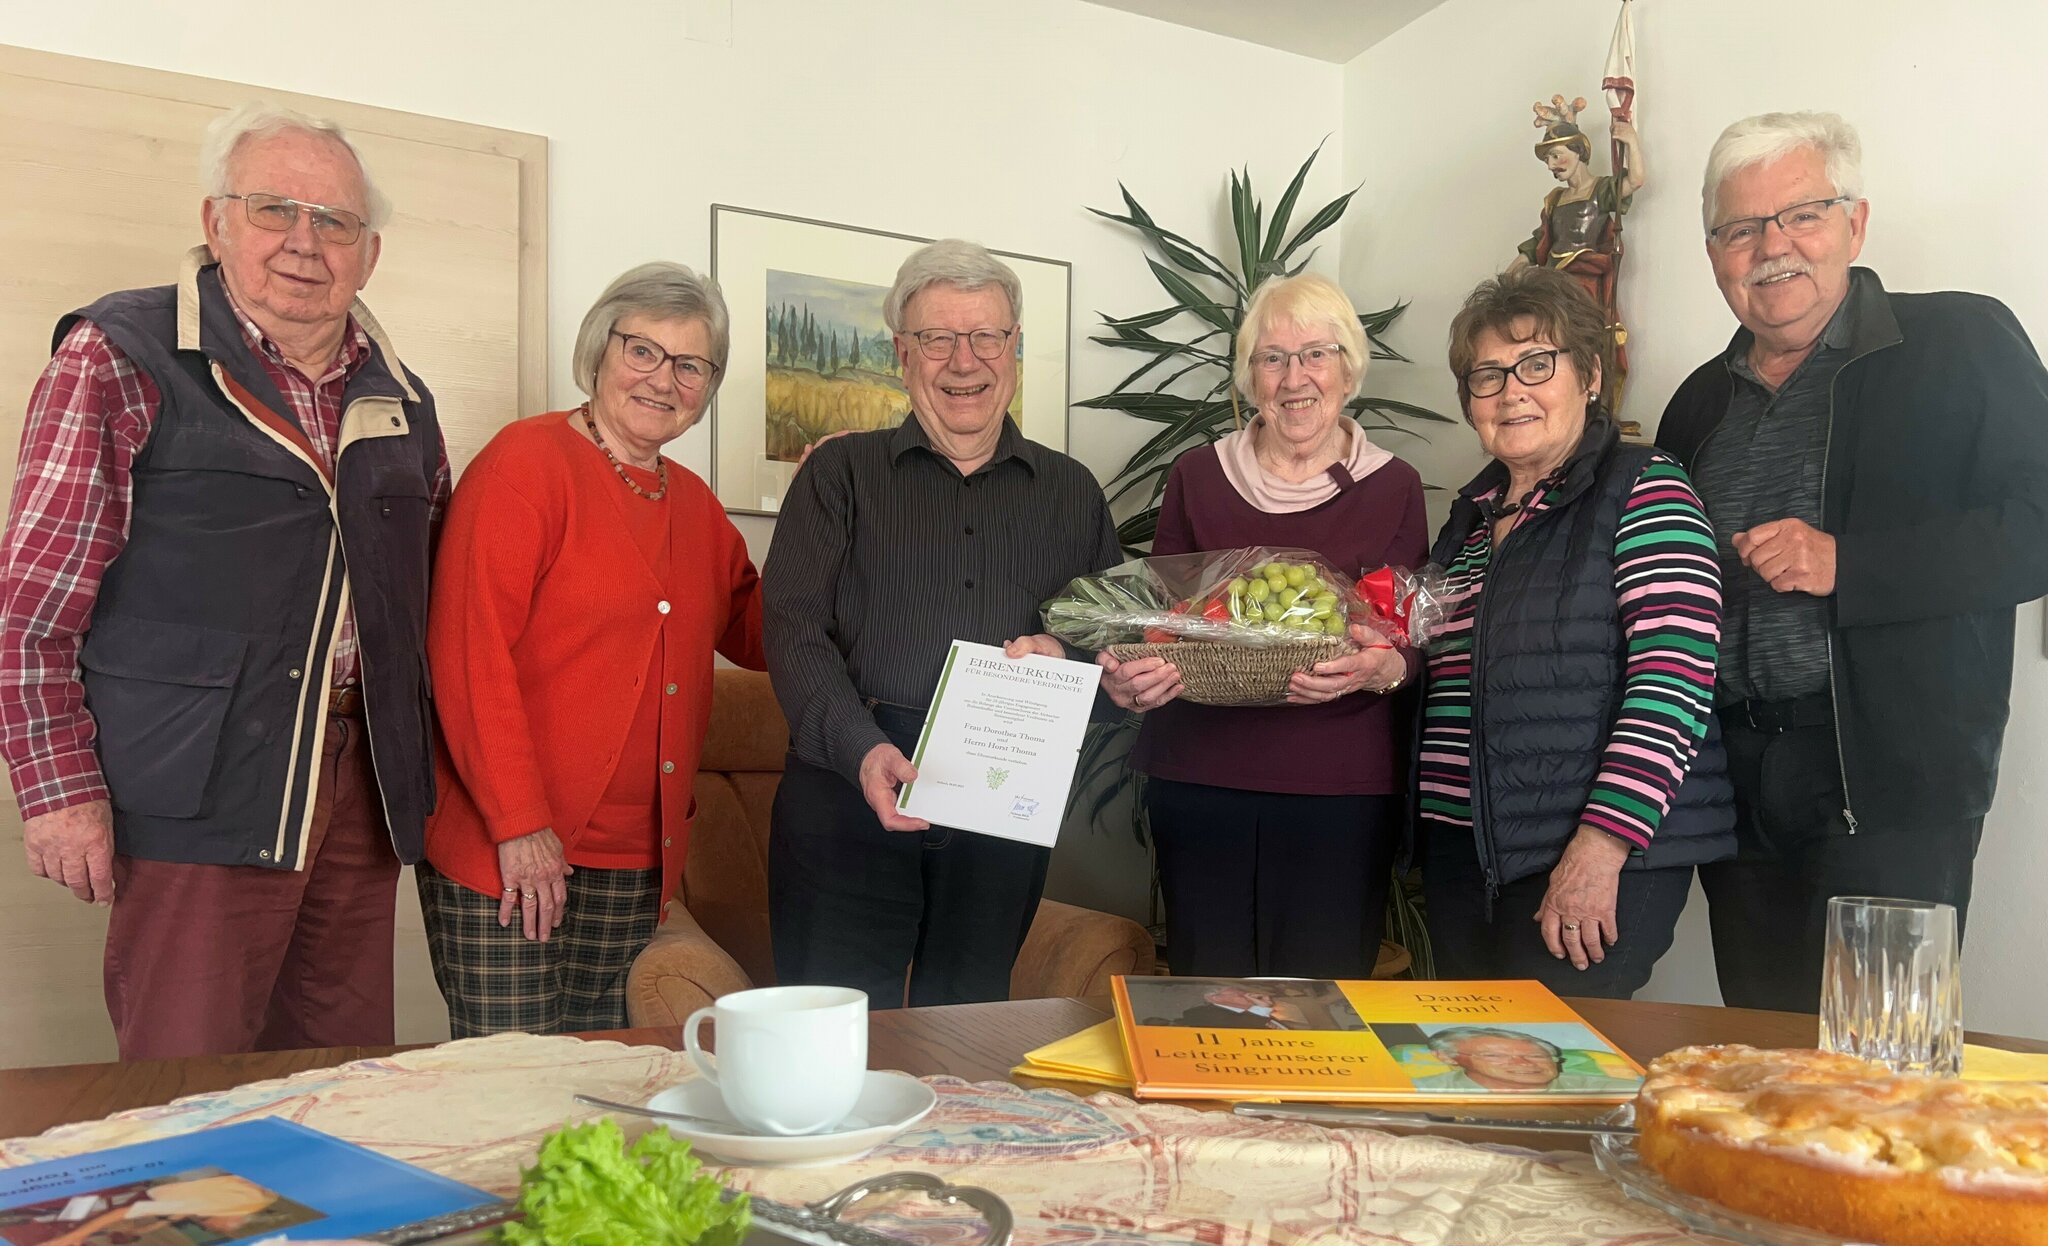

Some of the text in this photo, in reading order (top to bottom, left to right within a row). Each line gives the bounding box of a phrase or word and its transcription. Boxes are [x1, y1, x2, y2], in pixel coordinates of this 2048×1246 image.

[969, 657, 1085, 686] EHRENURKUNDE
[965, 667, 1083, 693] FÜR BESONDERE VERDIENSTE
[964, 722, 1046, 743] Frau Dorothea Thoma
[963, 737, 1038, 757] Herrn Horst Thoma
[1414, 994, 1513, 1004] Danke,
[1422, 1004, 1501, 1013] Toni!
[1195, 1032, 1316, 1049] 11 Jahre
[1154, 1048, 1370, 1064] Leiter unserer
[1195, 1062, 1353, 1077] Singrunde
[21, 1170, 71, 1186] Toni
[83, 1166, 138, 1181] Jahre
